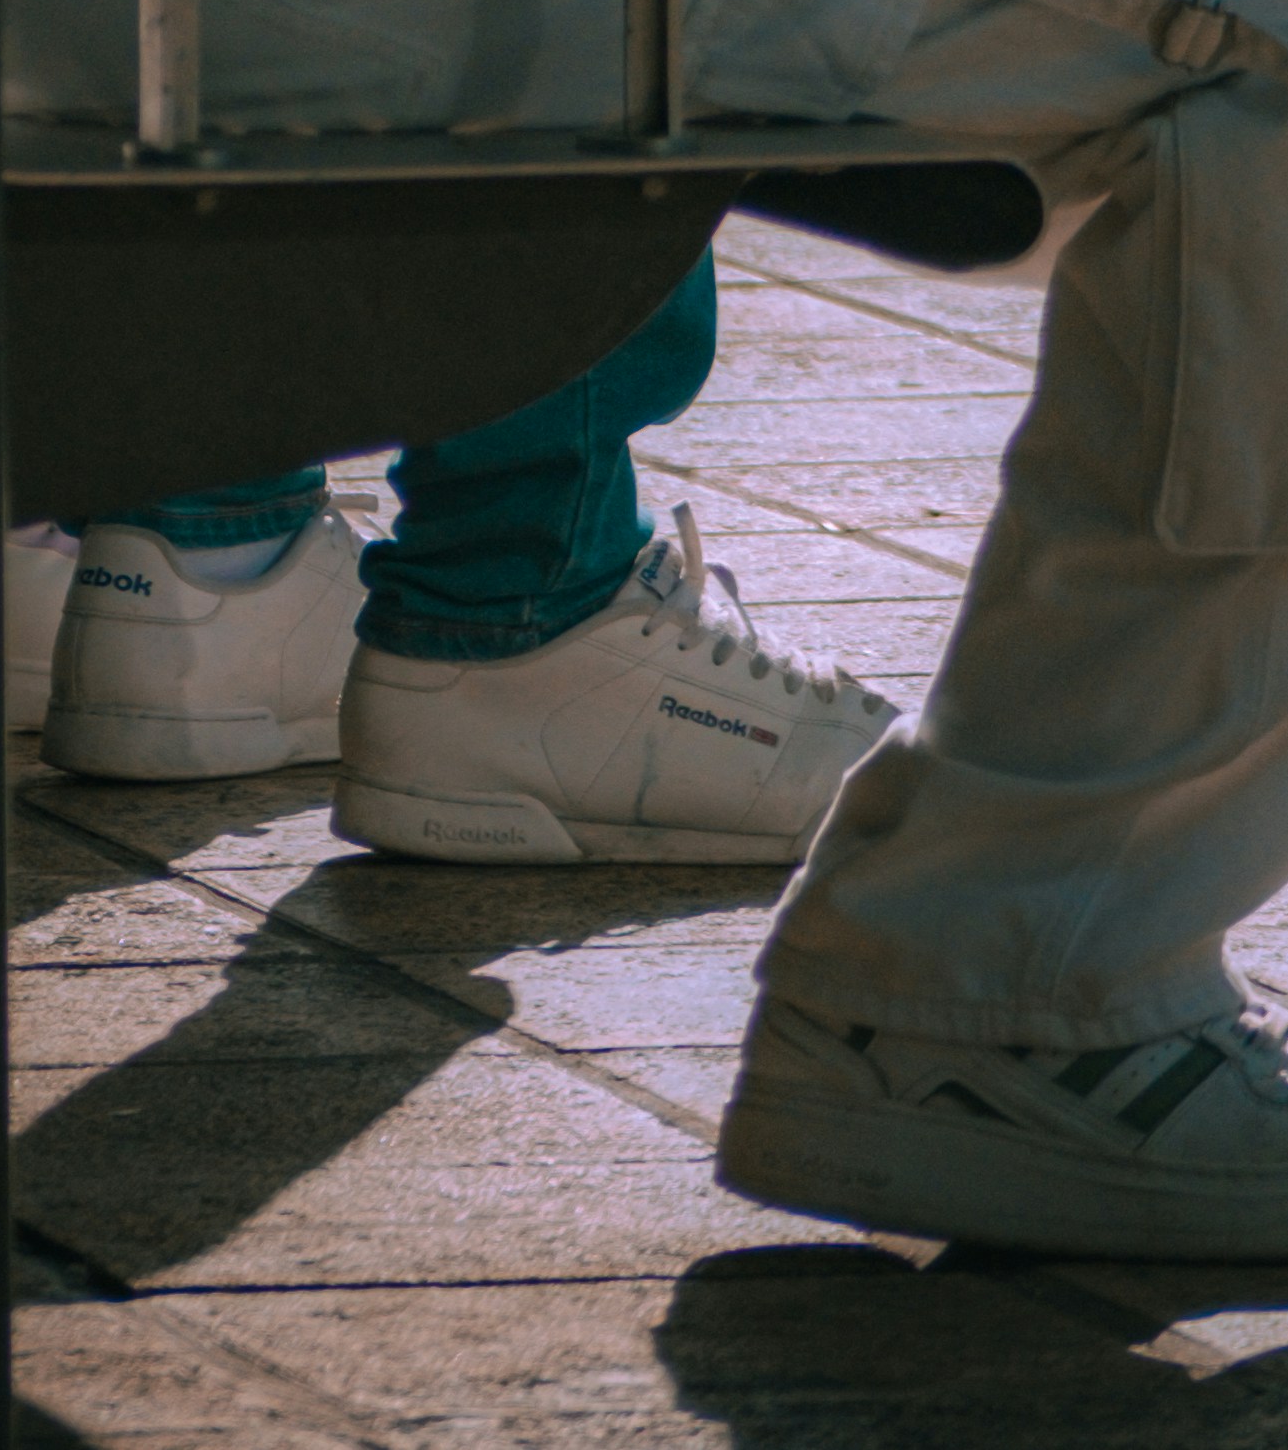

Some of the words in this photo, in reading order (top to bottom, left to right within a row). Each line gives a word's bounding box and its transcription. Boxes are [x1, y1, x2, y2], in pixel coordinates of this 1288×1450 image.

[77, 565, 154, 597] ebok
[658, 694, 748, 738] Reebok
[423, 817, 528, 846] Reebok
